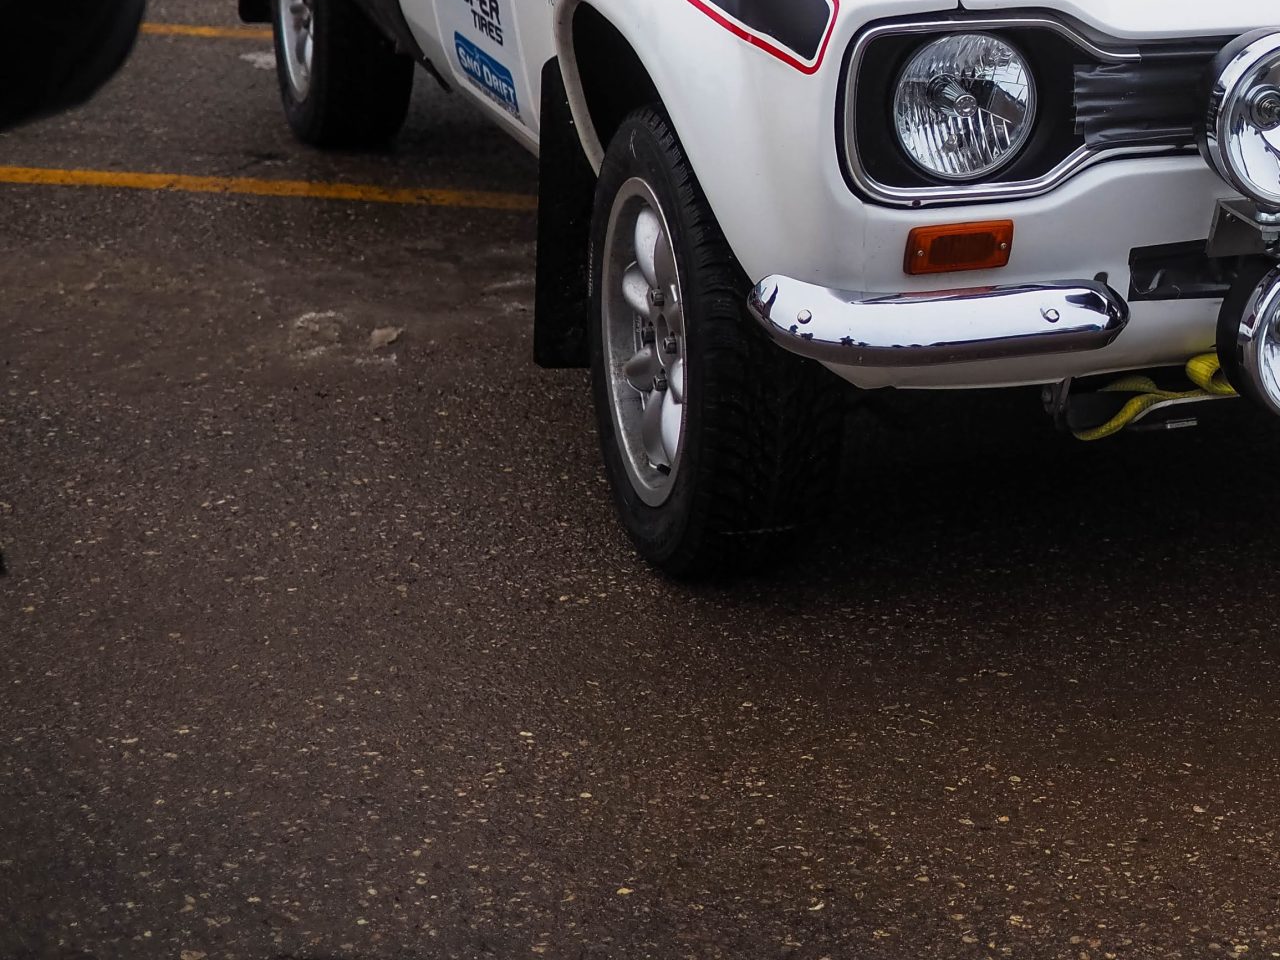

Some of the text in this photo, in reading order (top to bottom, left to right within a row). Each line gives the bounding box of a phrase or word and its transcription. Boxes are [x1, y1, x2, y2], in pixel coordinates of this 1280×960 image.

[470, 8, 504, 47] TIRES
[458, 46, 481, 77] SNO
[482, 64, 515, 106] DRIFT
